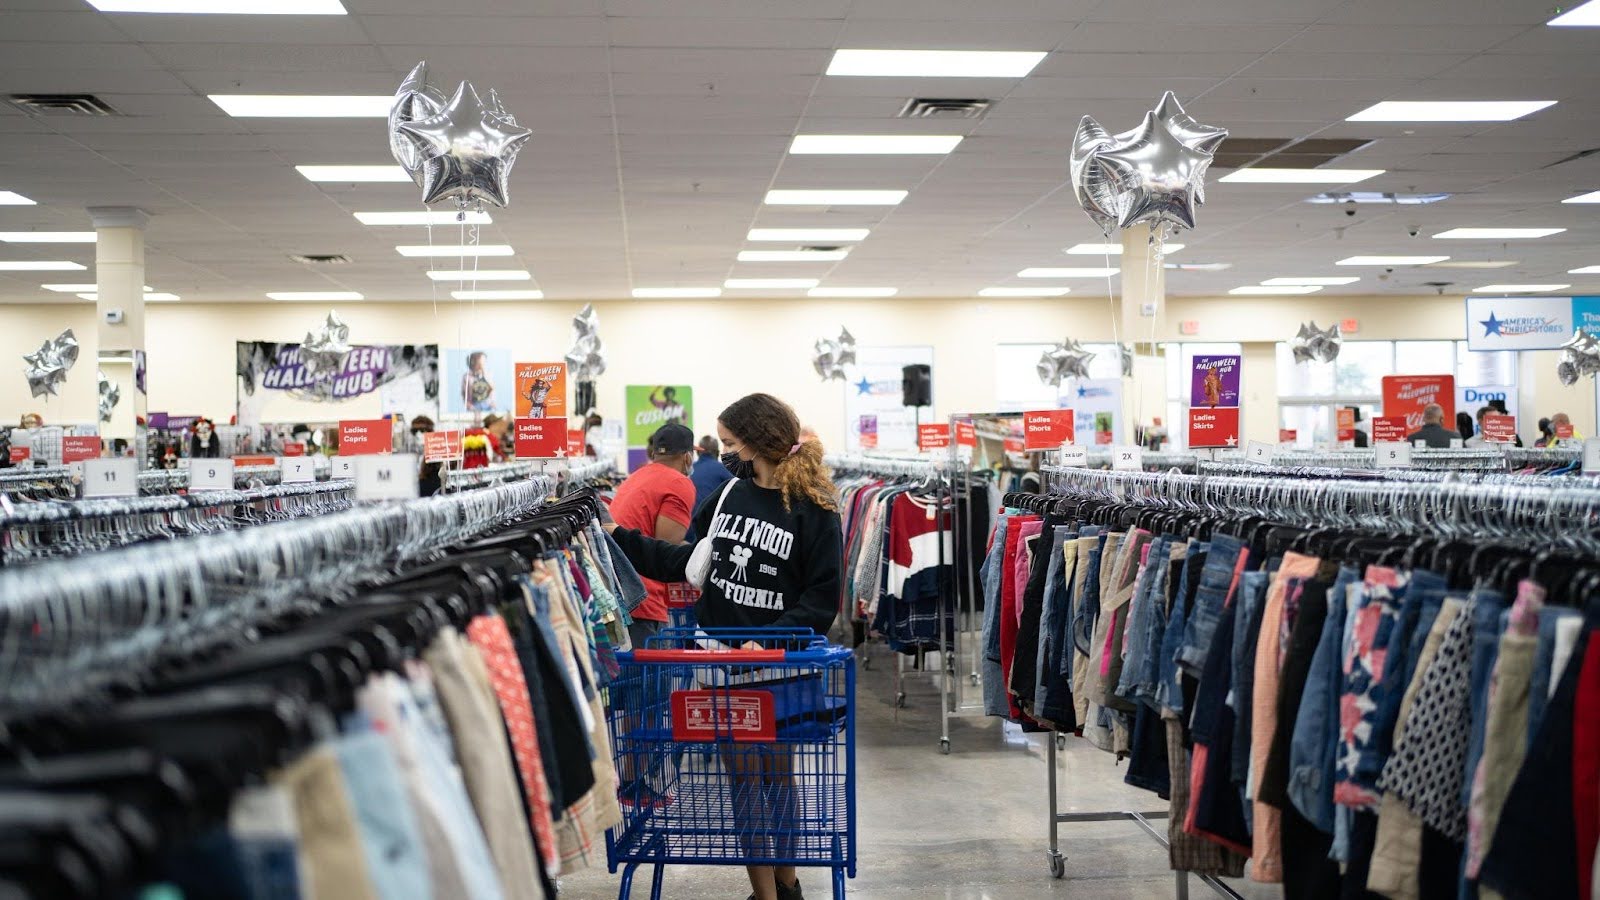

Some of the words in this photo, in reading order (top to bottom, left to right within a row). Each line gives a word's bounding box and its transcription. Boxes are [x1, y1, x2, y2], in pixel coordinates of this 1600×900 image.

[1505, 317, 1546, 325] AMERICA'S
[1534, 325, 1563, 333] STORES
[280, 349, 304, 367] TH
[264, 349, 385, 388] HALLEEN
[1195, 358, 1237, 370] HALLOWEEN
[519, 365, 562, 378] HALLOWEEN
[334, 371, 374, 396] HUB
[1464, 389, 1506, 402] Drop
[1257, 448, 1263, 456] 3
[1390, 451, 1396, 459] 5
[295, 465, 301, 473] 7
[343, 463, 349, 471] 5
[104, 471, 116, 482] 11
[208, 469, 216, 478] 9
[711, 513, 795, 561] OLLYWOOD
[758, 563, 778, 577] 1905
